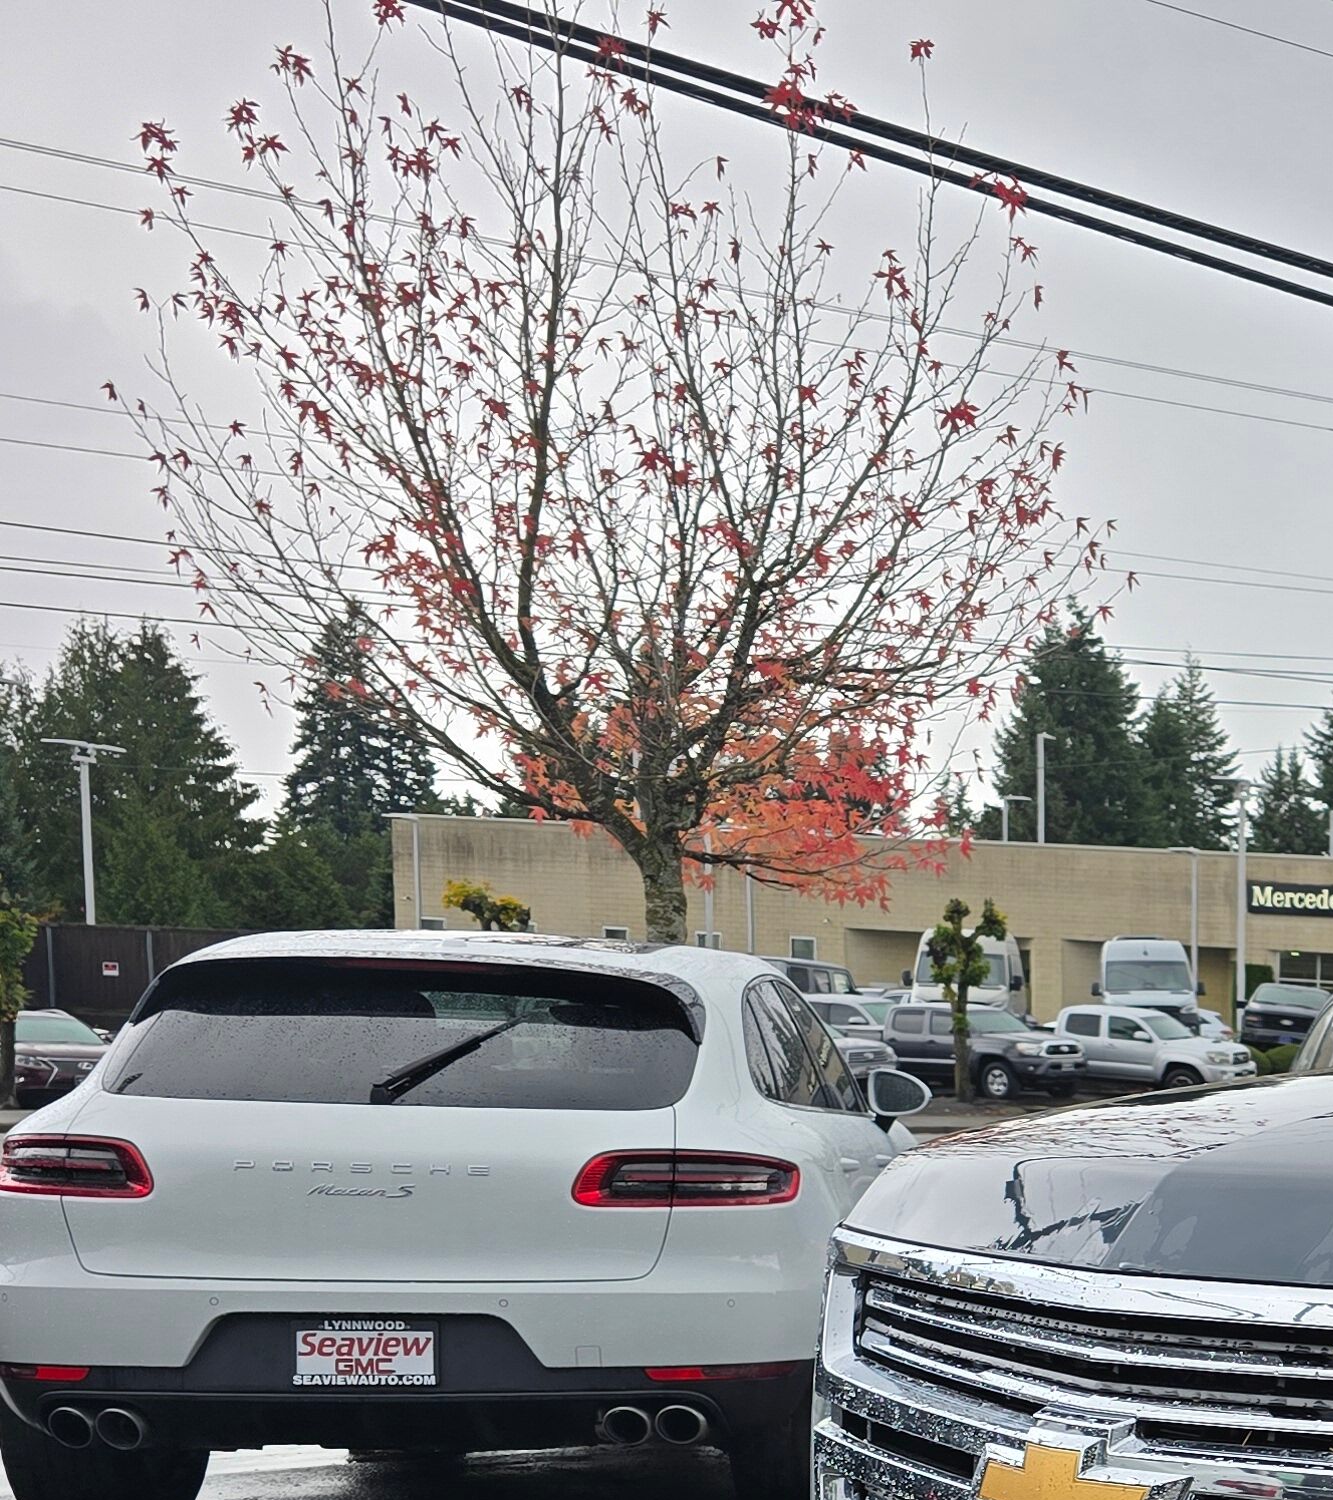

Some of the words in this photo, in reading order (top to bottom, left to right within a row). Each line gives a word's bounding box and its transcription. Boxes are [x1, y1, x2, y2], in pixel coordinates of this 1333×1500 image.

[233, 1159, 490, 1176] PORSCHE
[307, 1183, 387, 1197] Macan
[385, 1183, 416, 1198] S
[323, 1320, 406, 1330] LYNNWOOD
[298, 1332, 432, 1357] Seaview
[335, 1358, 396, 1375] GMC
[292, 1375, 436, 1386] SEAVIEWAUTO.COM
